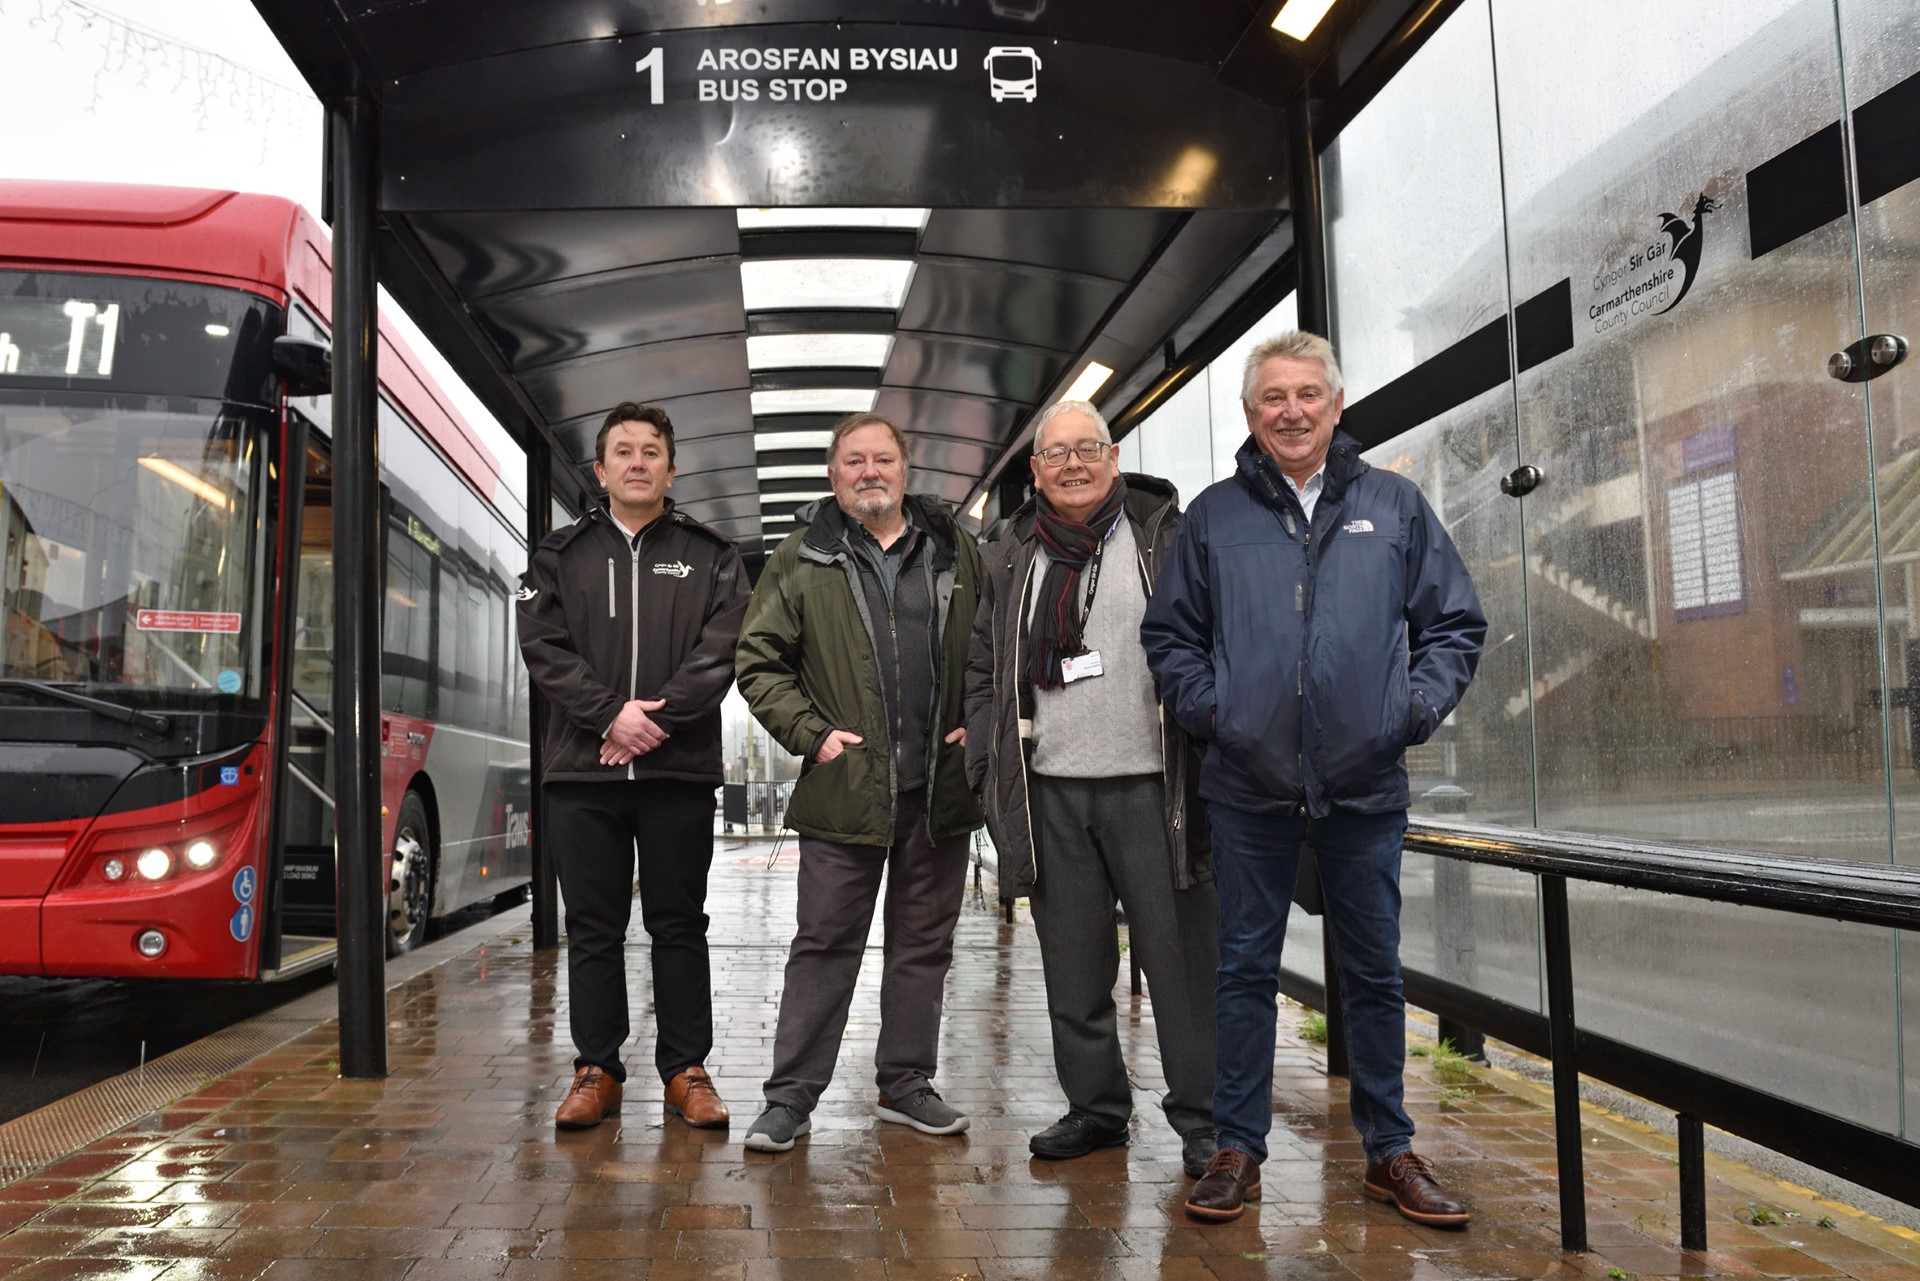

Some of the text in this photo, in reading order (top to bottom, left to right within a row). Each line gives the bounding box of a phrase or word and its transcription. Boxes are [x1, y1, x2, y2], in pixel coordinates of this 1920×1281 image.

[635, 47, 664, 105] 1
[697, 48, 958, 71] AROSFAN BYSIAU
[699, 78, 848, 102] BUS STOP
[1592, 242, 1667, 293] Cyngor Sir Gâr
[1589, 268, 1674, 320] Carmarthenshire
[1594, 284, 1670, 334] County Council
[63, 299, 120, 375] T1
